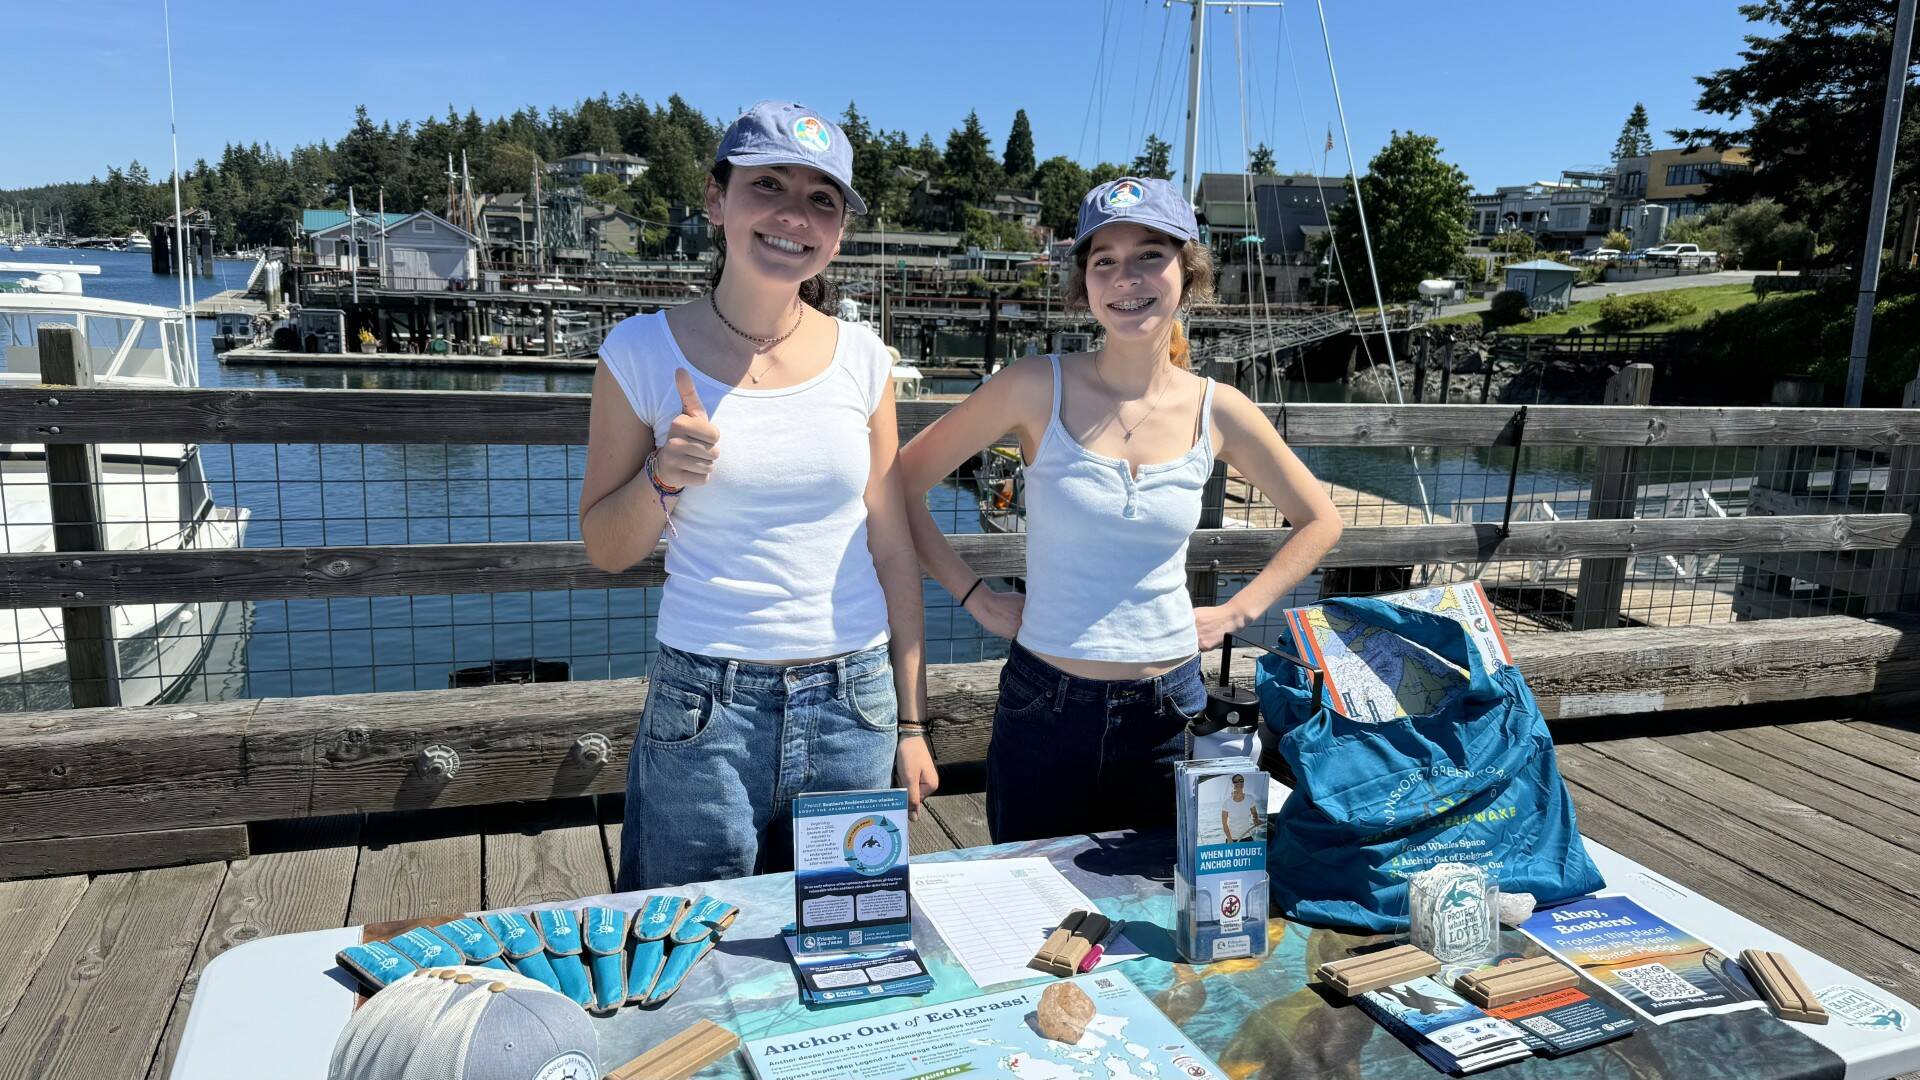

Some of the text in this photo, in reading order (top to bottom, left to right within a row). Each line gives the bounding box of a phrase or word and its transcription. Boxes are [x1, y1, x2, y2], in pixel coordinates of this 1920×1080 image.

[1474, 806, 1517, 823] WAKE
[1460, 838, 1486, 849] Space
[1200, 847, 1263, 860] WHEN IN DOUBT,
[1392, 857, 1400, 866] 2
[1402, 855, 1432, 866] Anchor
[1434, 855, 1448, 863] Out
[1449, 854, 1459, 862] of
[1200, 858, 1251, 870] ANCHOR OUT!
[1488, 861, 1504, 869] Out
[1447, 906, 1476, 922] PROTECT
[1551, 908, 1609, 923] Ahoy,
[1449, 923, 1479, 943] LOVE
[1552, 915, 1638, 935] Boaters!
[1556, 926, 1670, 948] Protect this place!
[1575, 934, 1675, 954] Take the Green
[1589, 947, 1634, 961] Boater
[764, 1032, 852, 1056] Anchor
[857, 1022, 900, 1037] Out
[904, 1016, 920, 1027] of
[925, 995, 1030, 1023] Eelgrass!
[769, 1057, 796, 1066] Anchor
[799, 1051, 825, 1061] deeper
[875, 1037, 894, 1045] avoid
[896, 1030, 932, 1041] damaging
[933, 1024, 964, 1033] sensitive
[811, 1067, 835, 1075] Depth
[837, 1063, 853, 1071] Map
[855, 1056, 883, 1066] Legend
[891, 1047, 930, 1059] Anchorage
